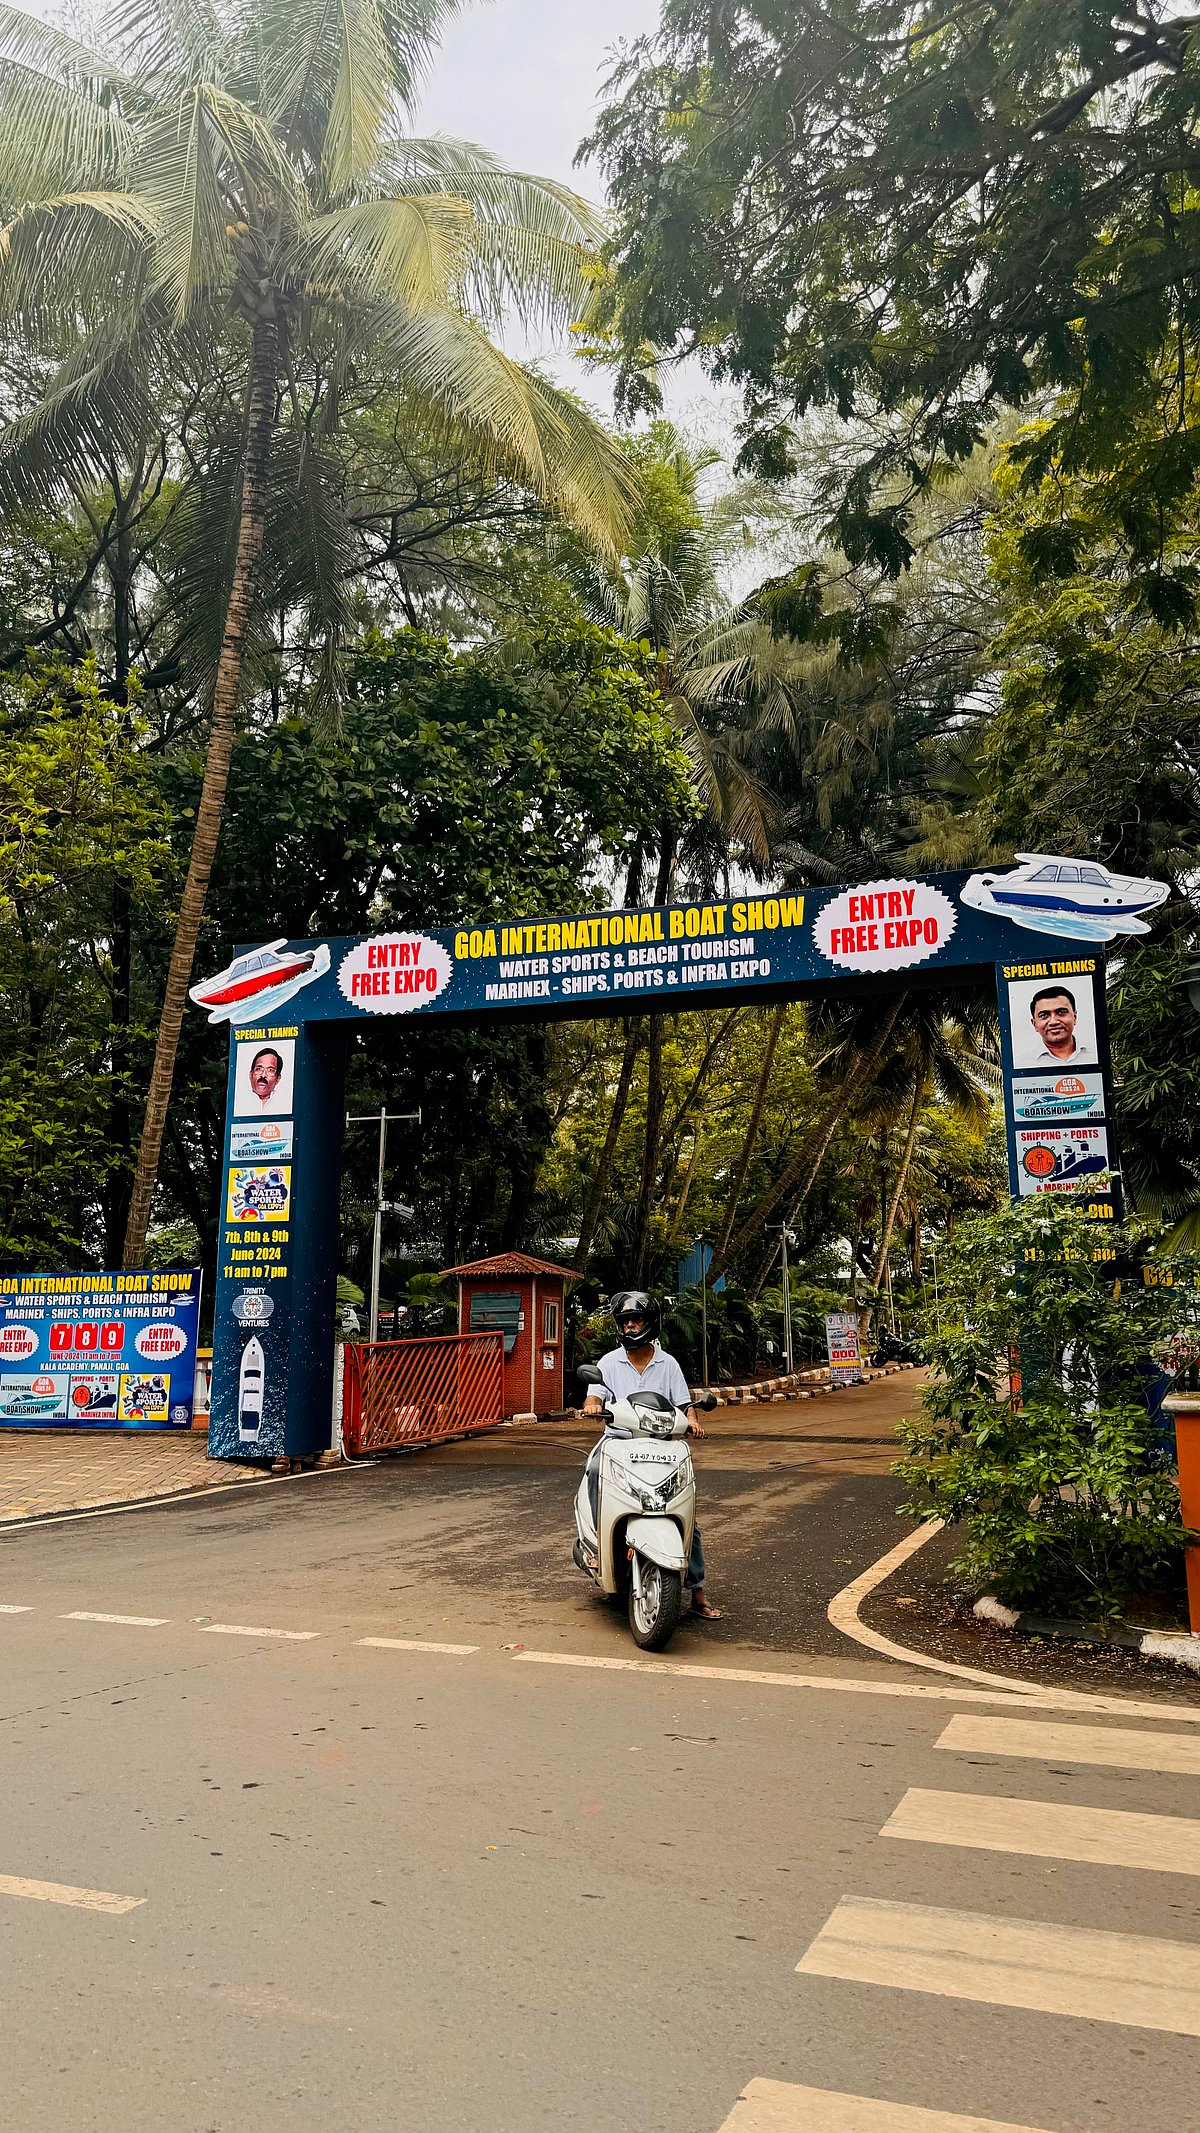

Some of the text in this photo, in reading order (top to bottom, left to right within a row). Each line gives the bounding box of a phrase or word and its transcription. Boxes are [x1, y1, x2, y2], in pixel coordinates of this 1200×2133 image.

[848, 888, 915, 922] ENTRY
[454, 896, 805, 959] GOA INTERNATIONAL BOAT SHOW
[830, 917, 939, 954] FREE EXPO
[367, 942, 422, 968] ENTRY
[499, 937, 755, 978] WATER SPORTS & BEACH TOURISM
[1003, 959, 1096, 978] SPECIAL THANKS
[351, 967, 438, 997] FREE EXPO
[485, 979, 550, 1001] MARINEX
[561, 974, 611, 993] SHIPS,
[613, 968, 664, 990] PORTS
[667, 970, 679, 985] &
[681, 962, 728, 983] INFRA
[730, 959, 771, 978] EXPO
[235, 1026, 299, 1040] SPECIAL THANKS
[1014, 1087, 1054, 1095] INTERNATIONAL
[1046, 1106, 1070, 1115] SHOW
[1020, 1131, 1061, 1141] SHIPPING
[1070, 1129, 1099, 1139] PORTS
[251, 1189, 281, 1197] WATER
[249, 1196, 283, 1204] SPORTS
[225, 1230, 289, 1244] 7th, 8th & 9th
[231, 1247, 281, 1261] June 2024
[223, 1265, 287, 1279] 11 am to 7 pm
[20, 1276, 114, 1294] INTERNATIONAL
[116, 1275, 149, 1292] BOAT
[151, 1274, 192, 1291] SHOW
[243, 1287, 266, 1295] TRINITY
[15, 1293, 168, 1306] WATER SPORTS & BEACH TOURISM
[5, 1309, 44, 1319] MARINEX
[51, 1308, 81, 1319] SHIPS,
[82, 1308, 112, 1318] PORTS
[113, 1309, 121, 1317] &
[123, 1307, 150, 1317] INFRA
[151, 1306, 175, 1317] EXPO
[3, 1329, 27, 1340] ENTRY
[58, 1330, 117, 1346] 7 8 9
[148, 1328, 174, 1339] ENTRY
[14, 1341, 33, 1352] EXPO
[140, 1340, 181, 1352] FREE EXPO
[82, 1352, 88, 1360] 11
[40, 1363, 56, 1371] KALA
[115, 1363, 129, 1371] GOA
[22, 1405, 41, 1413] SHOW
